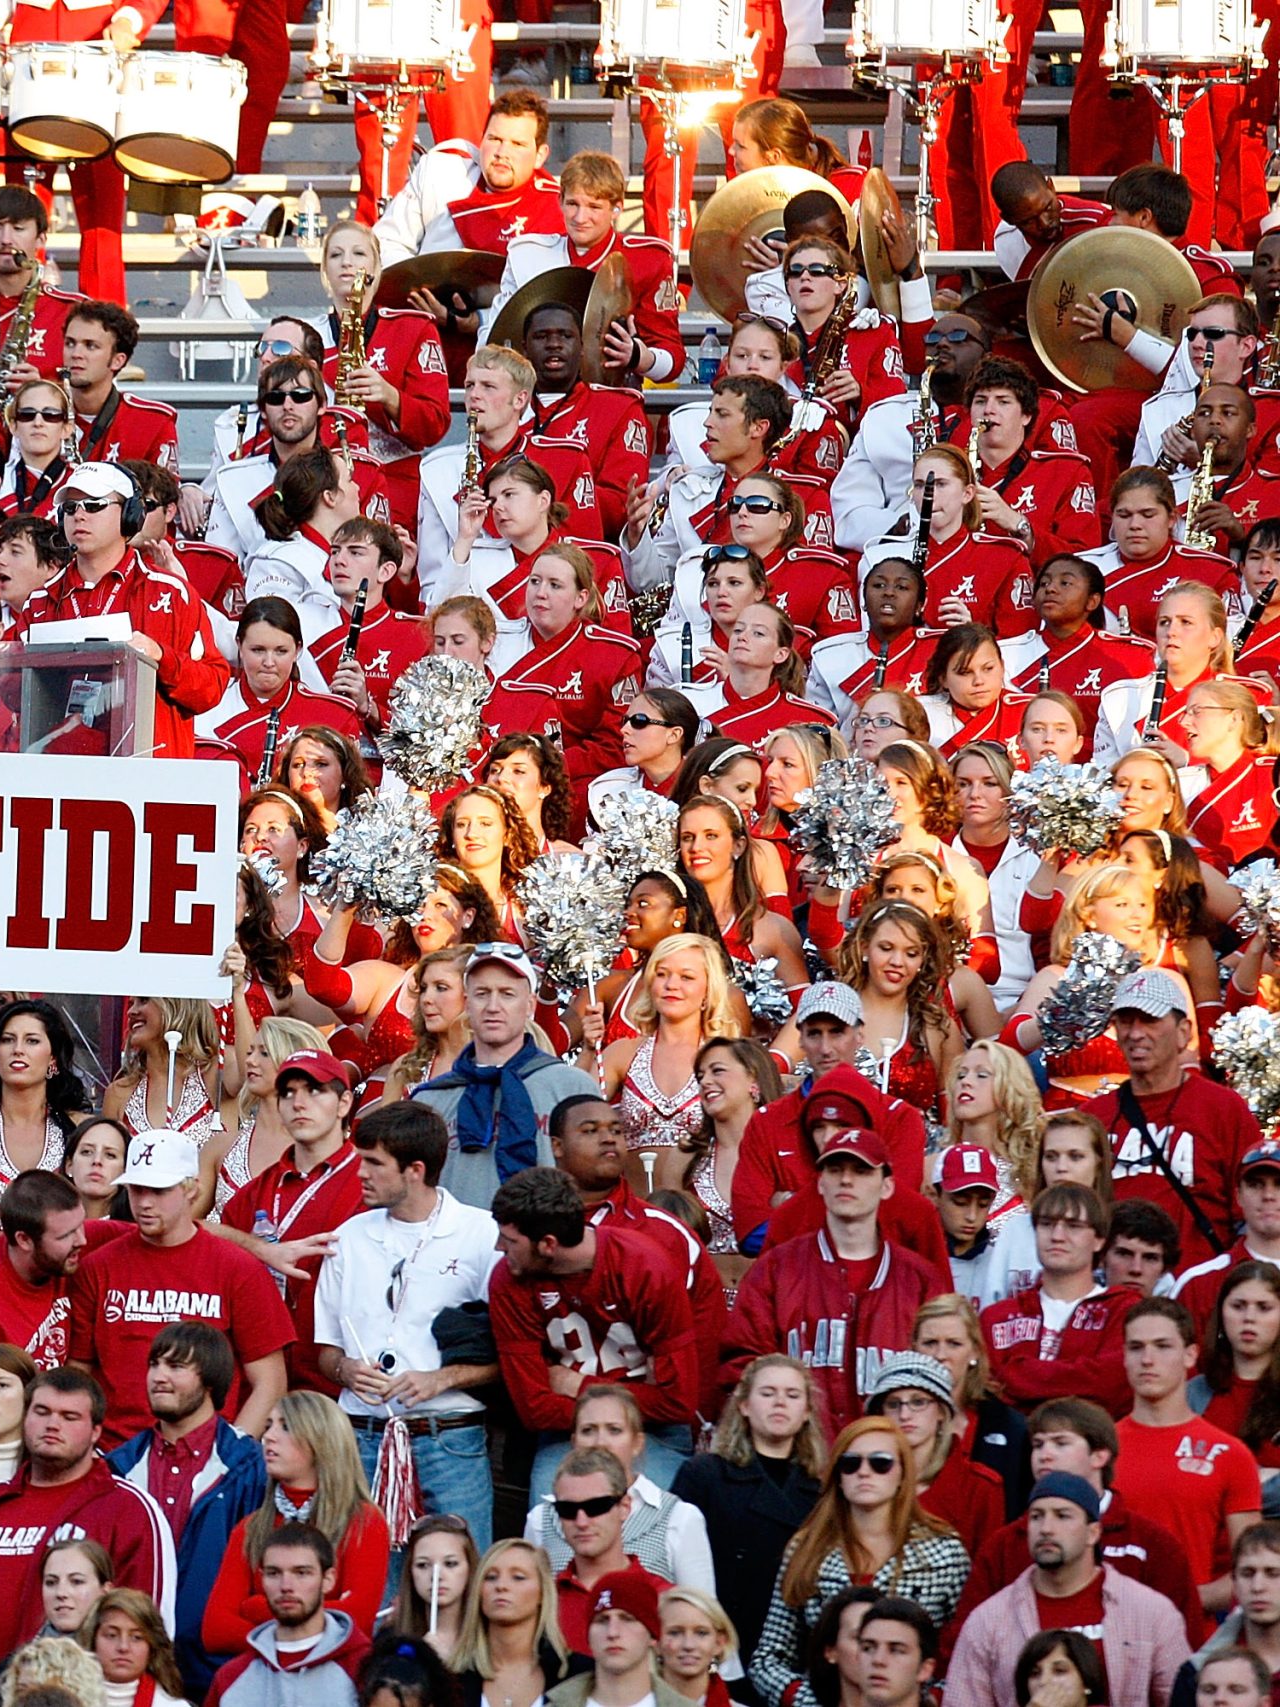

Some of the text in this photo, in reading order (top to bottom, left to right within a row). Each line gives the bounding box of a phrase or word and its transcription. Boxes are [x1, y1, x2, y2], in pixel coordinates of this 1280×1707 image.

[1010, 484, 1035, 508] A
[1234, 500, 1260, 518] A
[251, 575, 291, 592] UNIVERSITY
[951, 575, 975, 597] A
[149, 592, 173, 614] A
[364, 649, 392, 673] A
[558, 670, 583, 694] A
[1076, 668, 1103, 690] A
[1232, 799, 1258, 826] A
[132, 1143, 157, 1166] A
[439, 1258, 459, 1277] A
[124, 1289, 222, 1319] ALABAMA
